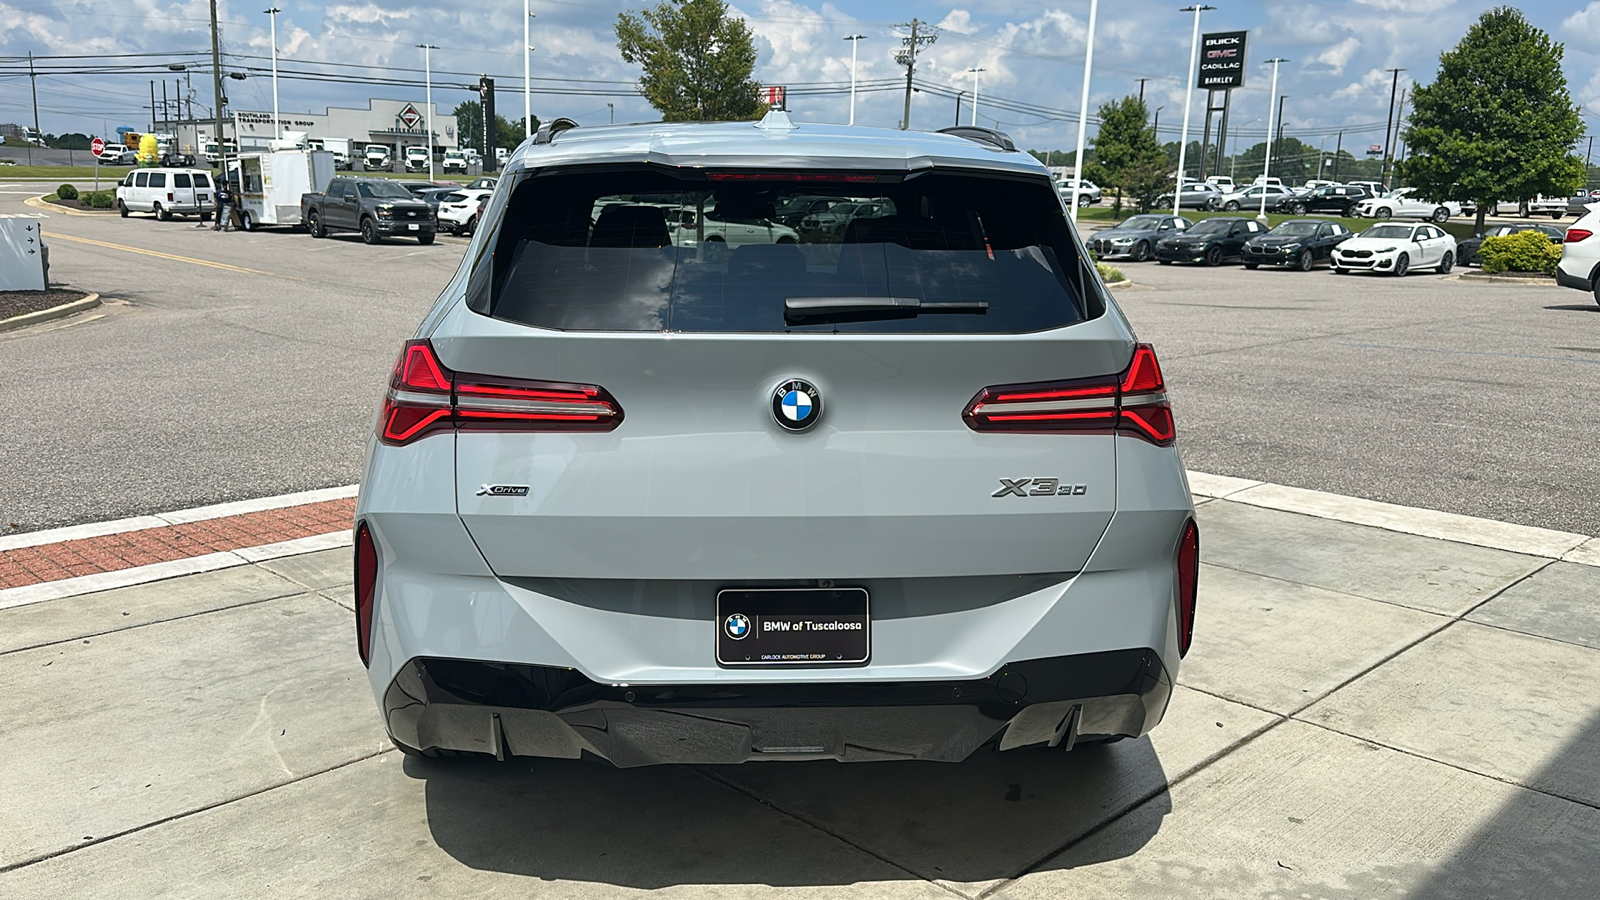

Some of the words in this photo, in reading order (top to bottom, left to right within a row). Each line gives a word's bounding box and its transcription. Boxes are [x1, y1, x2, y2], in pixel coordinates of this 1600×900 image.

[1206, 37, 1240, 46] BUICK
[1207, 49, 1237, 58] GMC
[1201, 62, 1240, 70] CADILLAC
[1204, 76, 1233, 84] BARKLEY
[91, 143, 104, 151] STOP
[777, 382, 817, 398] BMW
[763, 621, 790, 631] BMW
[792, 622, 803, 631] of
[805, 621, 862, 631] Tuscaloosa
